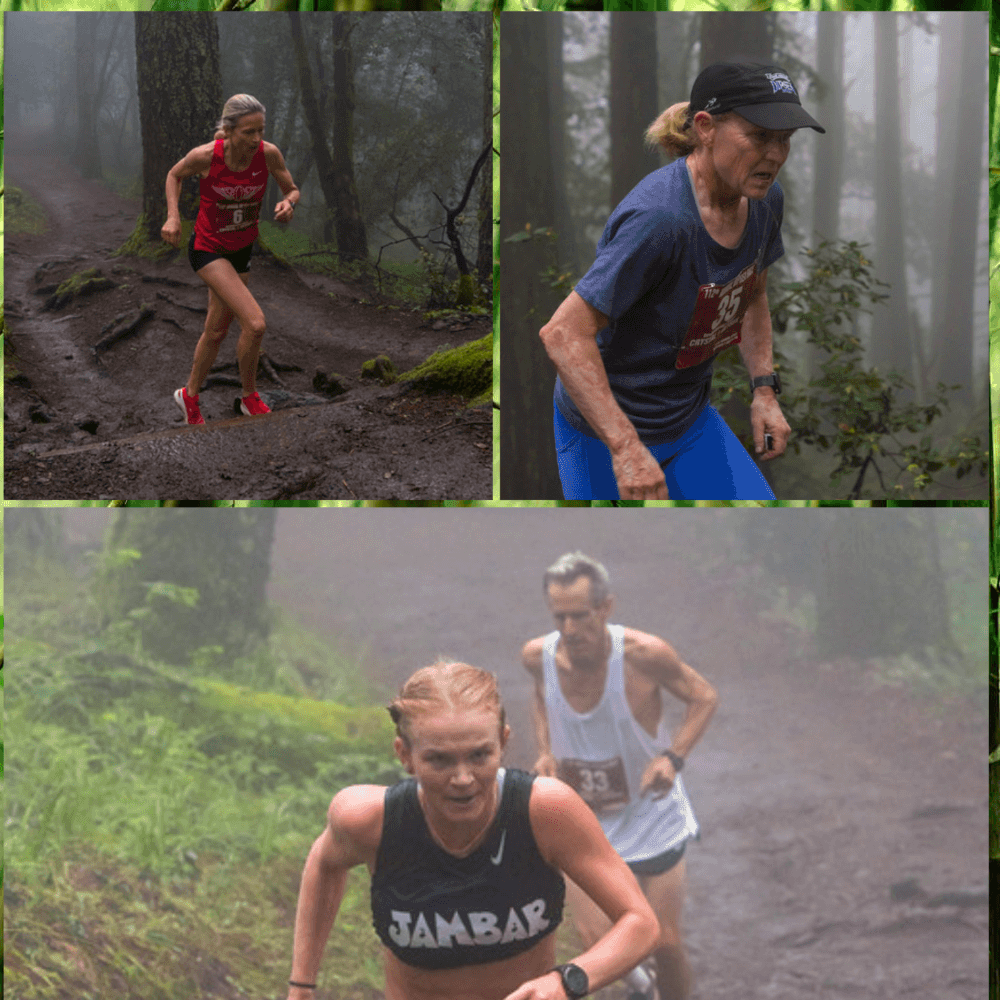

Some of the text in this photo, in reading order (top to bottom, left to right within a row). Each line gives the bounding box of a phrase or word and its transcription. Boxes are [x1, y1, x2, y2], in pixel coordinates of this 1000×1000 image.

[233, 209, 243, 224] 6
[711, 286, 743, 330] 35
[579, 769, 609, 791] 33
[388, 898, 550, 948] JAMBAR
